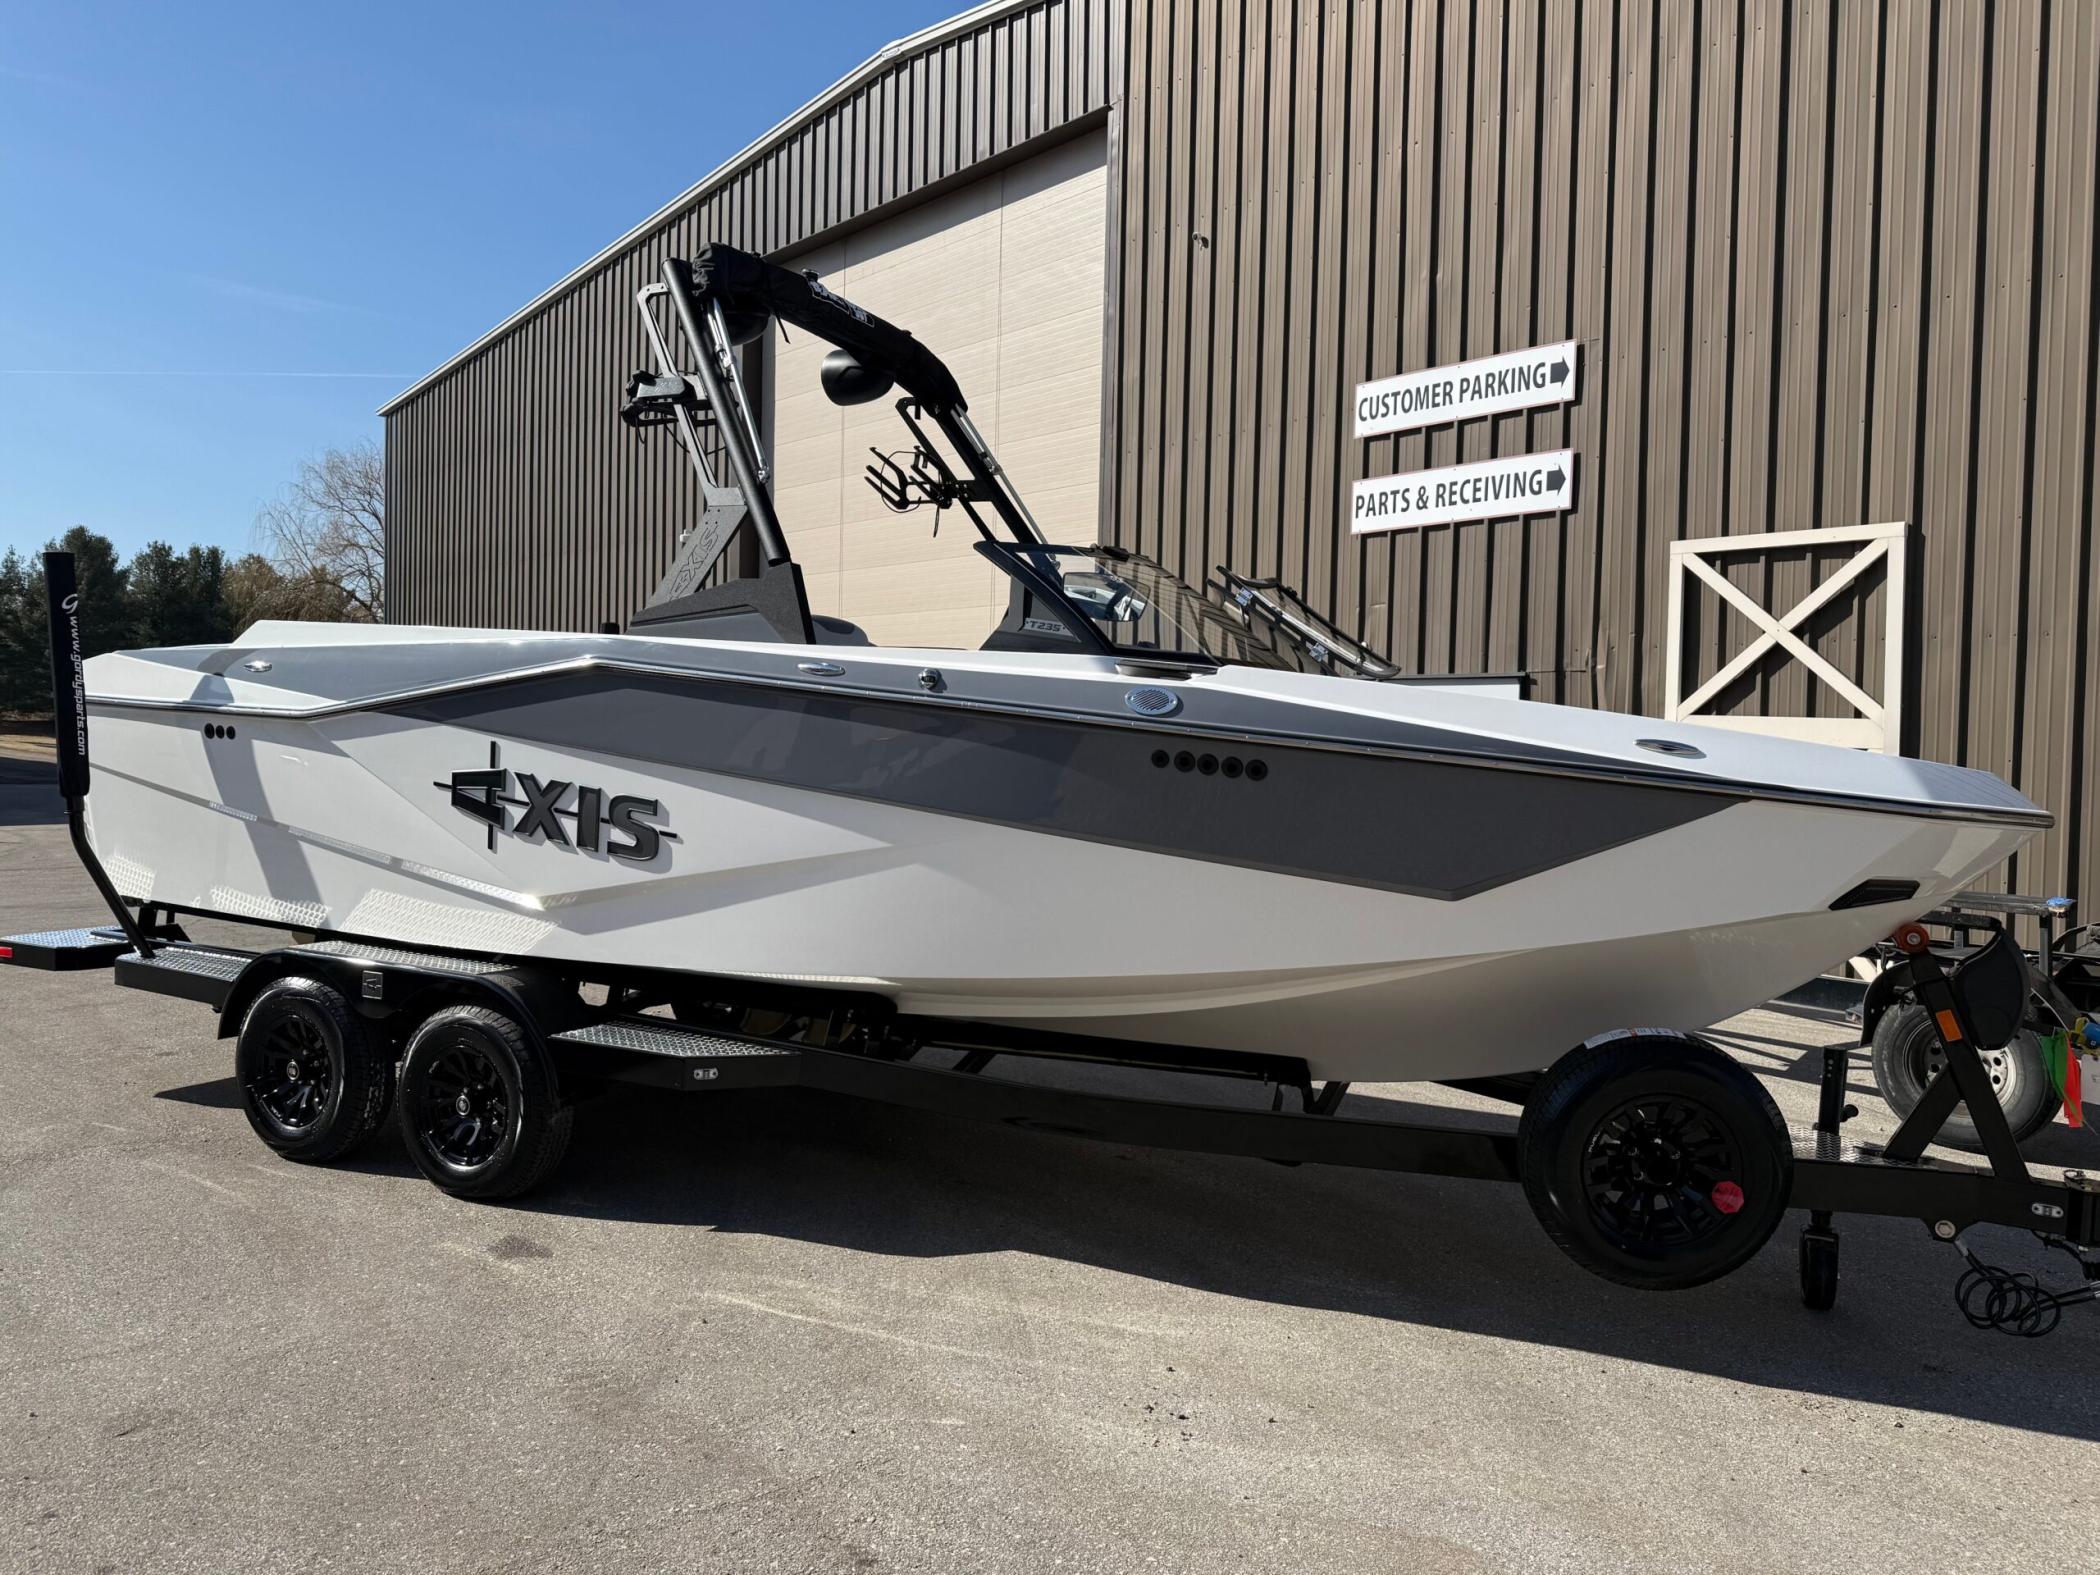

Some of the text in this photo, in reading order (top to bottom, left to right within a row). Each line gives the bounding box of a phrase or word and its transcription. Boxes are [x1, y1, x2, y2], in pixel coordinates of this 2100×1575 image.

[1358, 362, 1547, 422] CUSTOMER PARKING
[1355, 469, 1543, 519] PARTS & RECEIVING
[1030, 620, 1062, 632] T235
[69, 615, 85, 756] www.gordysparts.com
